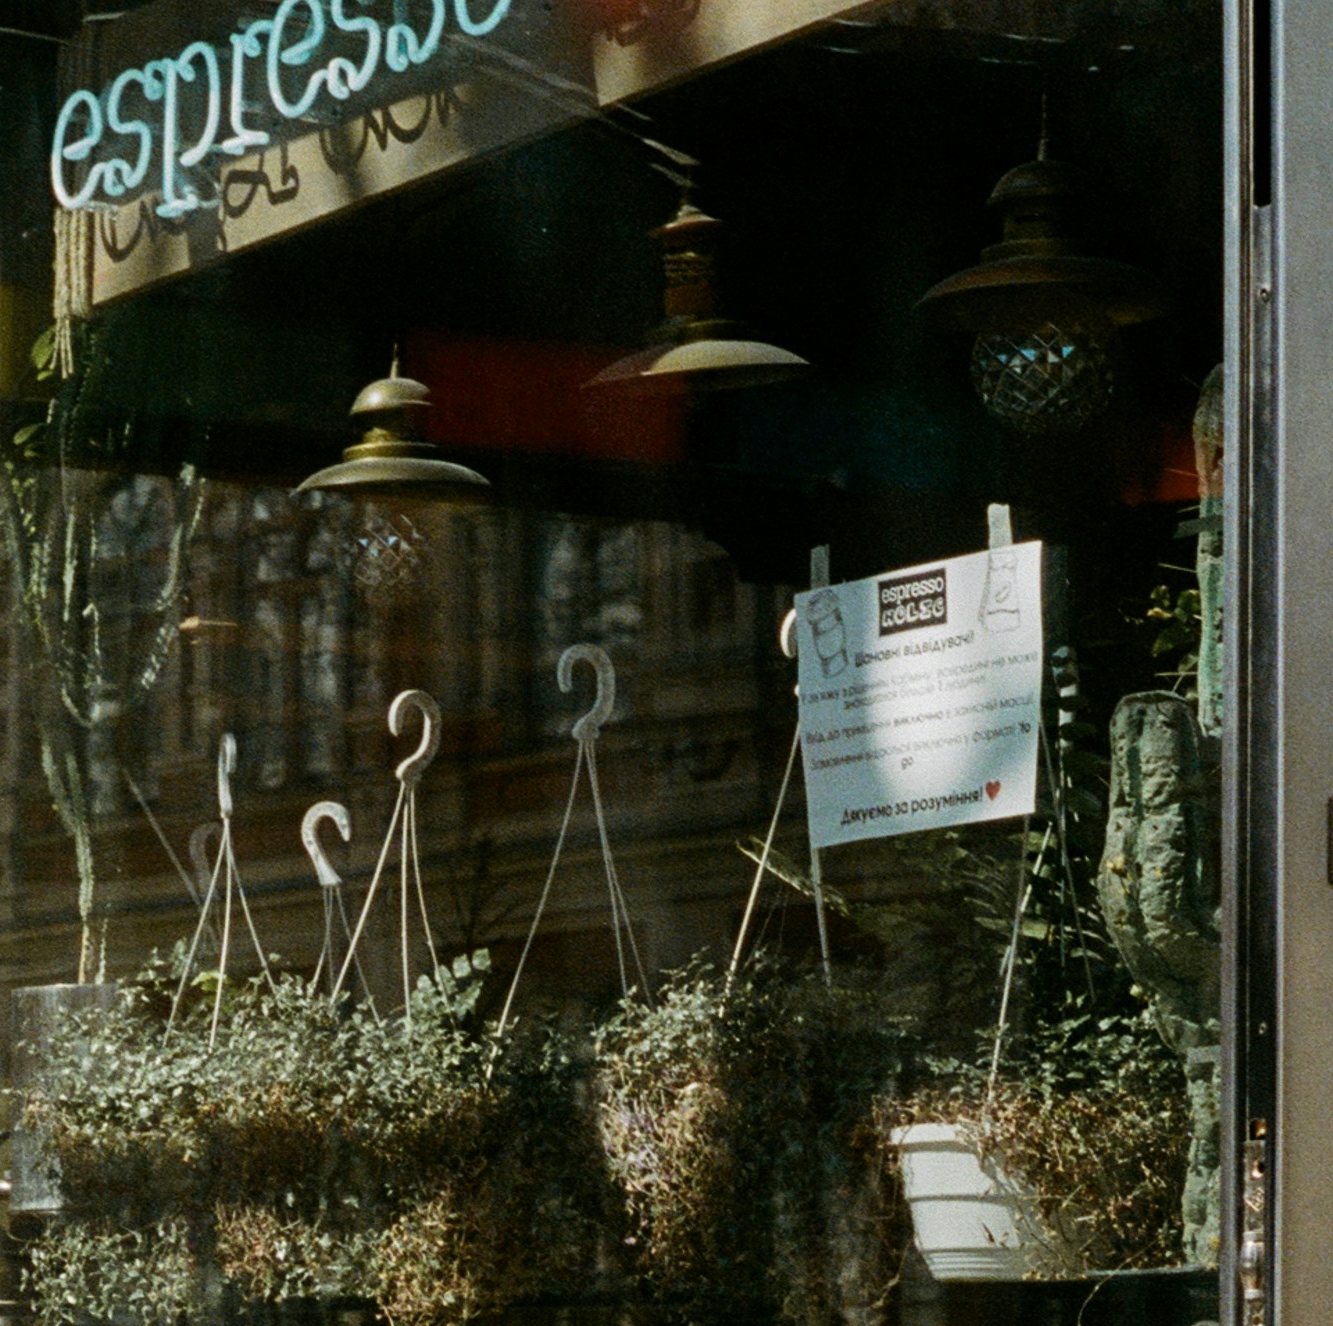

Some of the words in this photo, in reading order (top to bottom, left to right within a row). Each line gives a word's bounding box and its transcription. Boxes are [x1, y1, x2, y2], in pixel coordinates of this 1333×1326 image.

[881, 577, 944, 604] espresso
[855, 645, 901, 668] Шановні
[840, 804, 893, 826] Дякуємо
[895, 801, 909, 816] за
[911, 786, 983, 815] розуміння!
